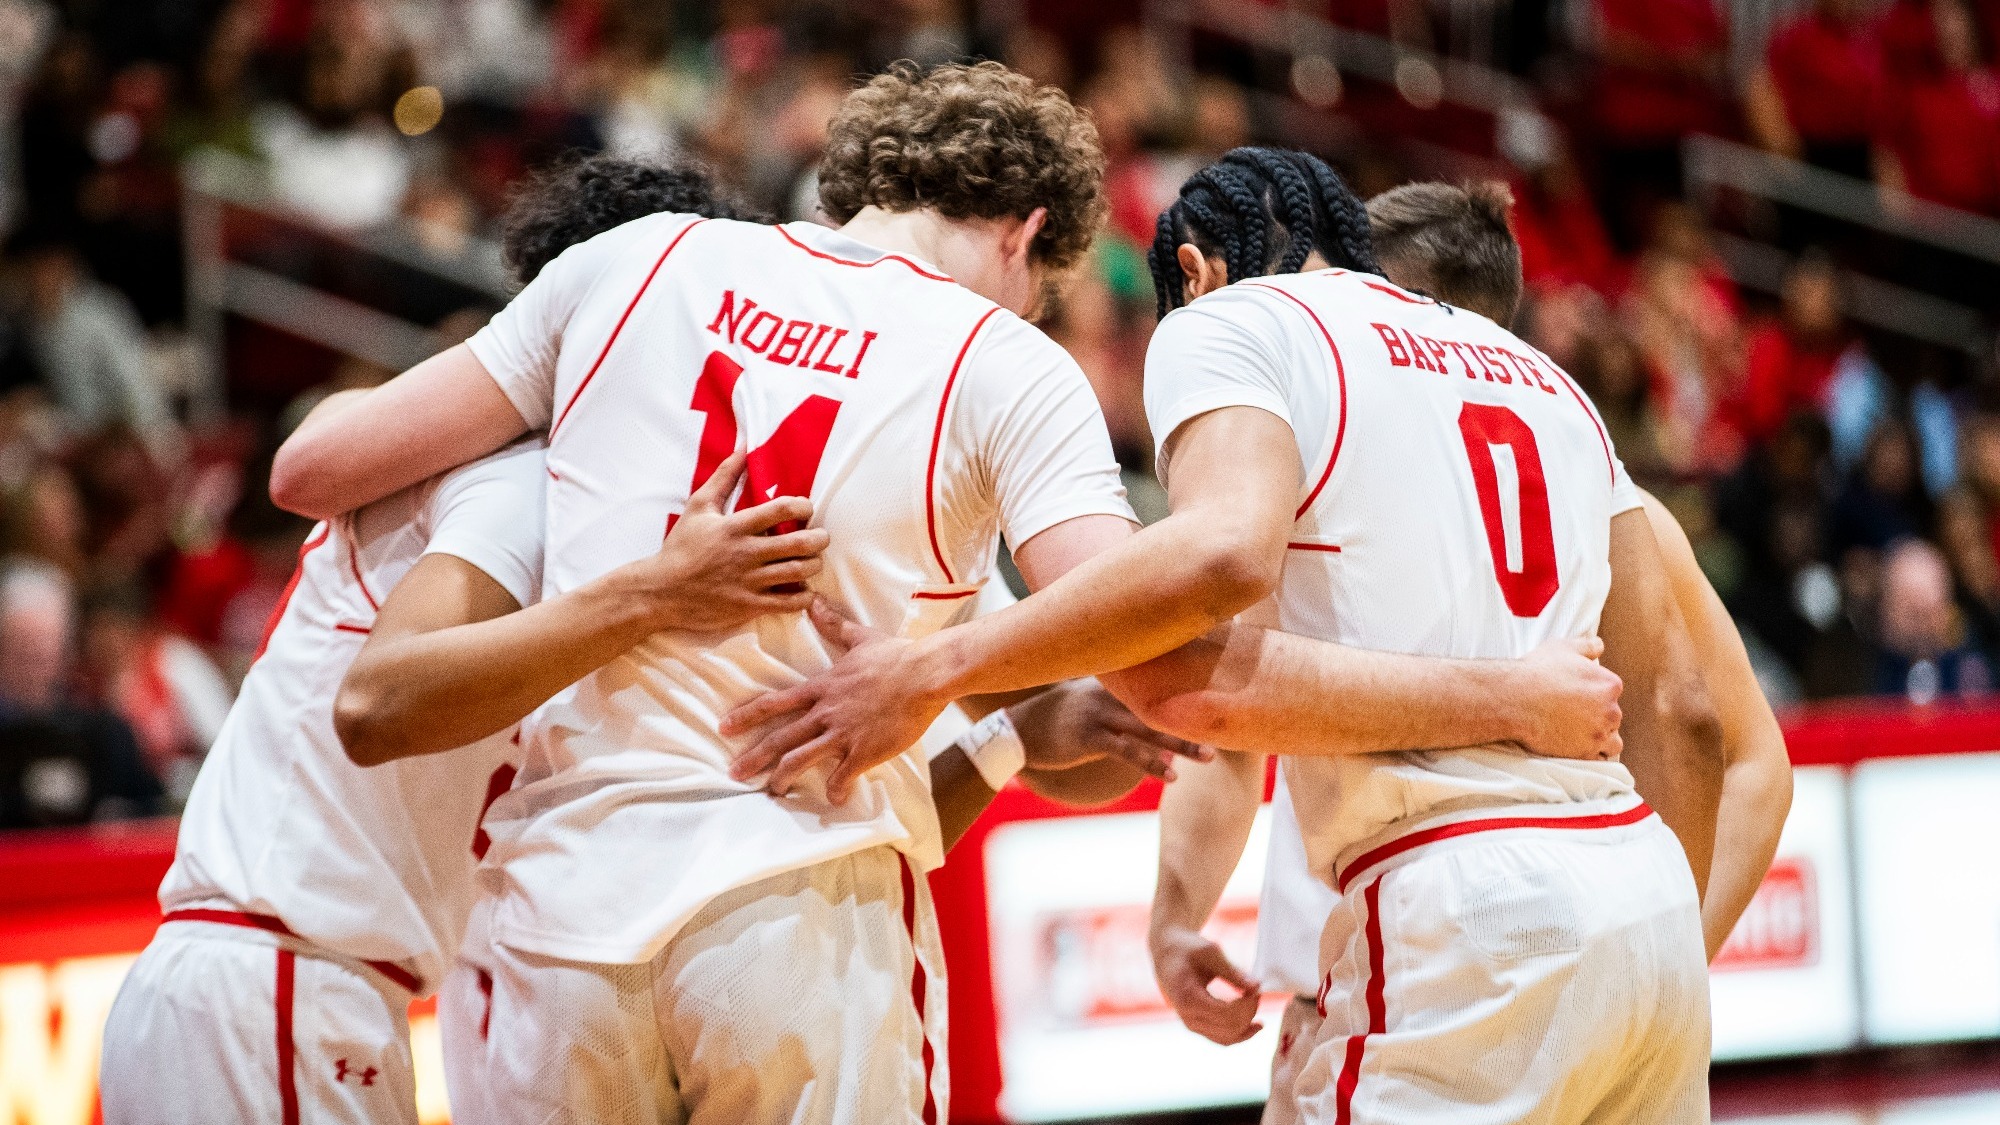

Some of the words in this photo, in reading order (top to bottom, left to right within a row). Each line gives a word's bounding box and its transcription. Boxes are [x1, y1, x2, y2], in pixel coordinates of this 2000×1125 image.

[706, 290, 878, 379] NOBILI
[1370, 322, 1557, 395] BAPTISTE
[663, 350, 843, 594] 14
[1457, 400, 1559, 618] 0
